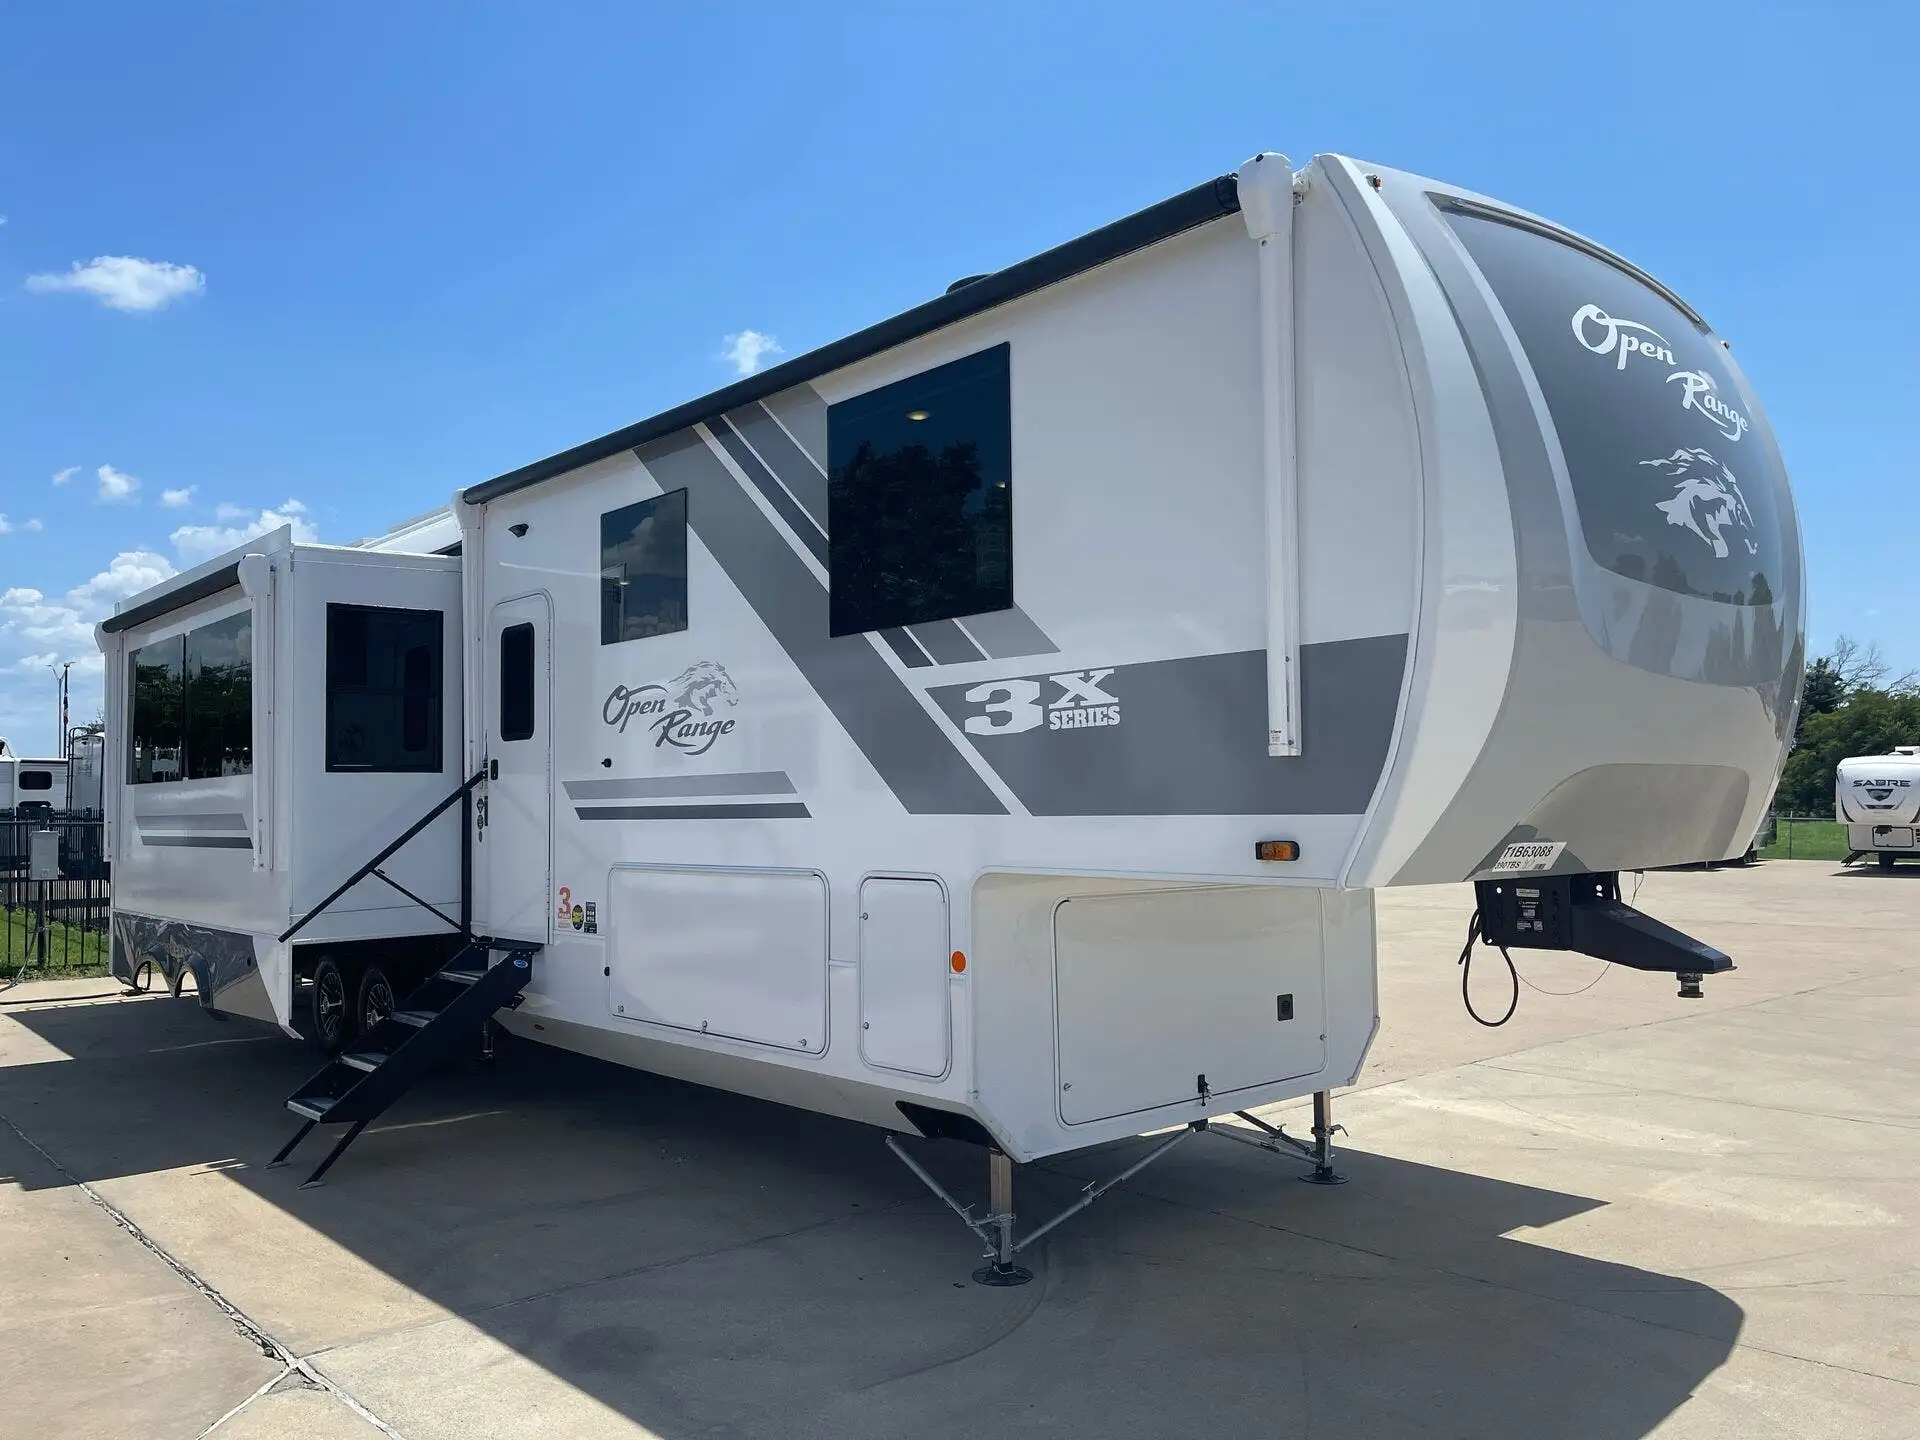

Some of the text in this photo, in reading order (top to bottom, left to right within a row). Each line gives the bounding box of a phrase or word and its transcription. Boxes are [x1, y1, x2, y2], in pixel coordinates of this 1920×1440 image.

[1571, 303, 1677, 371] Open
[1666, 370, 1749, 442] Range
[602, 684, 669, 734] Open
[1049, 706, 1121, 731] SERIES
[648, 708, 736, 756] Range
[1852, 779, 1912, 788] SABRE
[1503, 845, 1554, 858] T1B63088
[558, 886, 571, 914] 3
